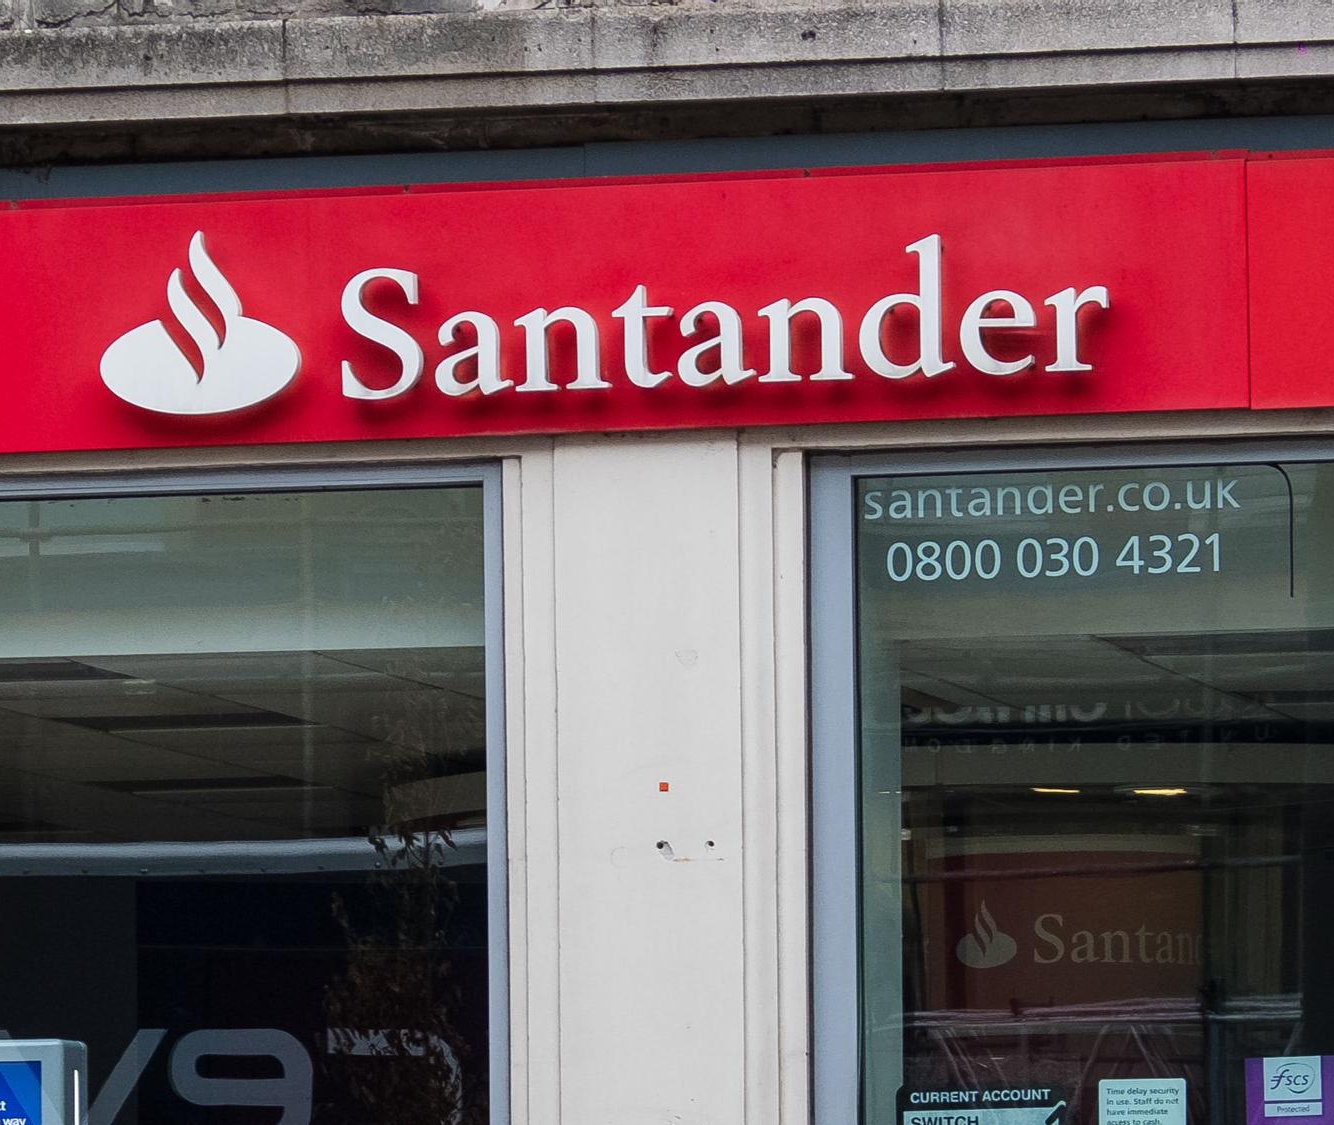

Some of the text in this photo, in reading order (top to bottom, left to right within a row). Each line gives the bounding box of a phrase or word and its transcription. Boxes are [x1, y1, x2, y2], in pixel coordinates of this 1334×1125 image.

[341, 234, 1109, 400] Santander
[863, 478, 1241, 521] santander.co.uk
[886, 533, 1222, 582] 0800 030 4321
[910, 1088, 1052, 1105] CURRENT ACCOUNT
[1127, 1087, 1147, 1096] delay
[1149, 1087, 1179, 1095] security
[1277, 1105, 1311, 1113] Protected
